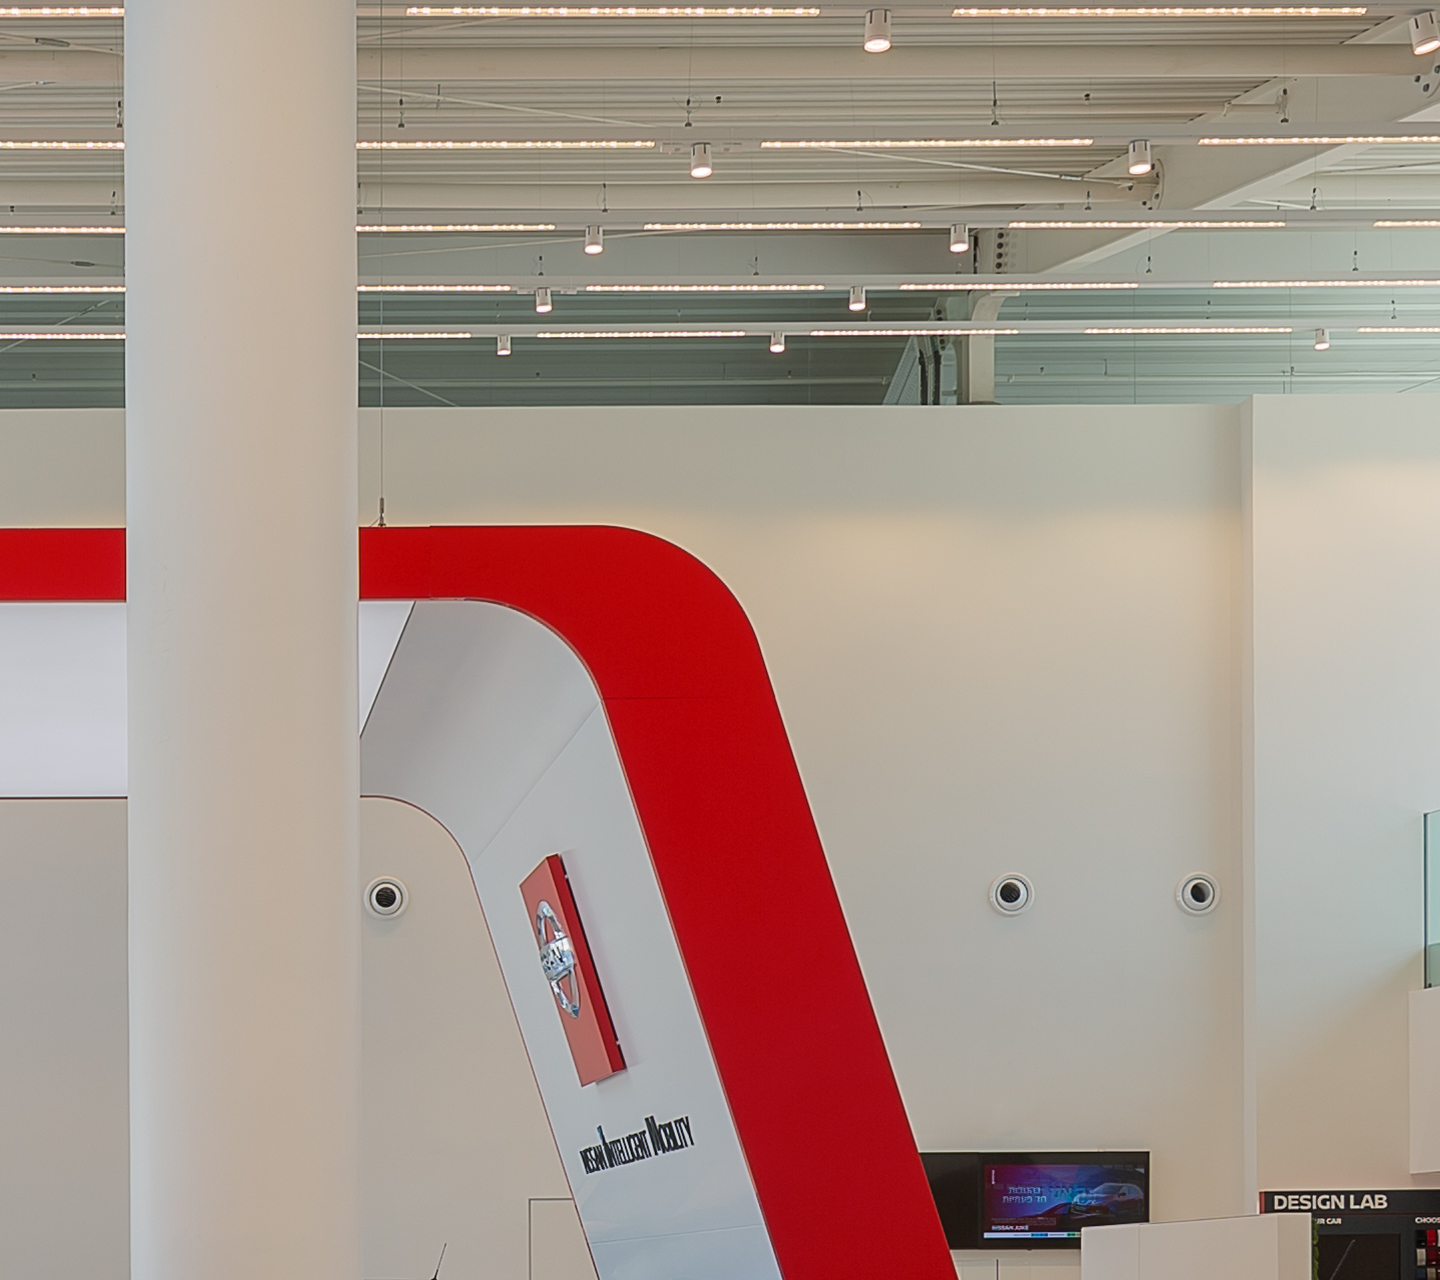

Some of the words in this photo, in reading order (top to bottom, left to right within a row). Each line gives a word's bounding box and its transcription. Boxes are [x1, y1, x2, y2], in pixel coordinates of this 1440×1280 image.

[644, 1115, 694, 1156] MOBILITY
[1273, 1195, 1345, 1211] DESIGN
[1349, 1194, 1389, 1210] LAB
[1326, 1217, 1342, 1225] CAR
